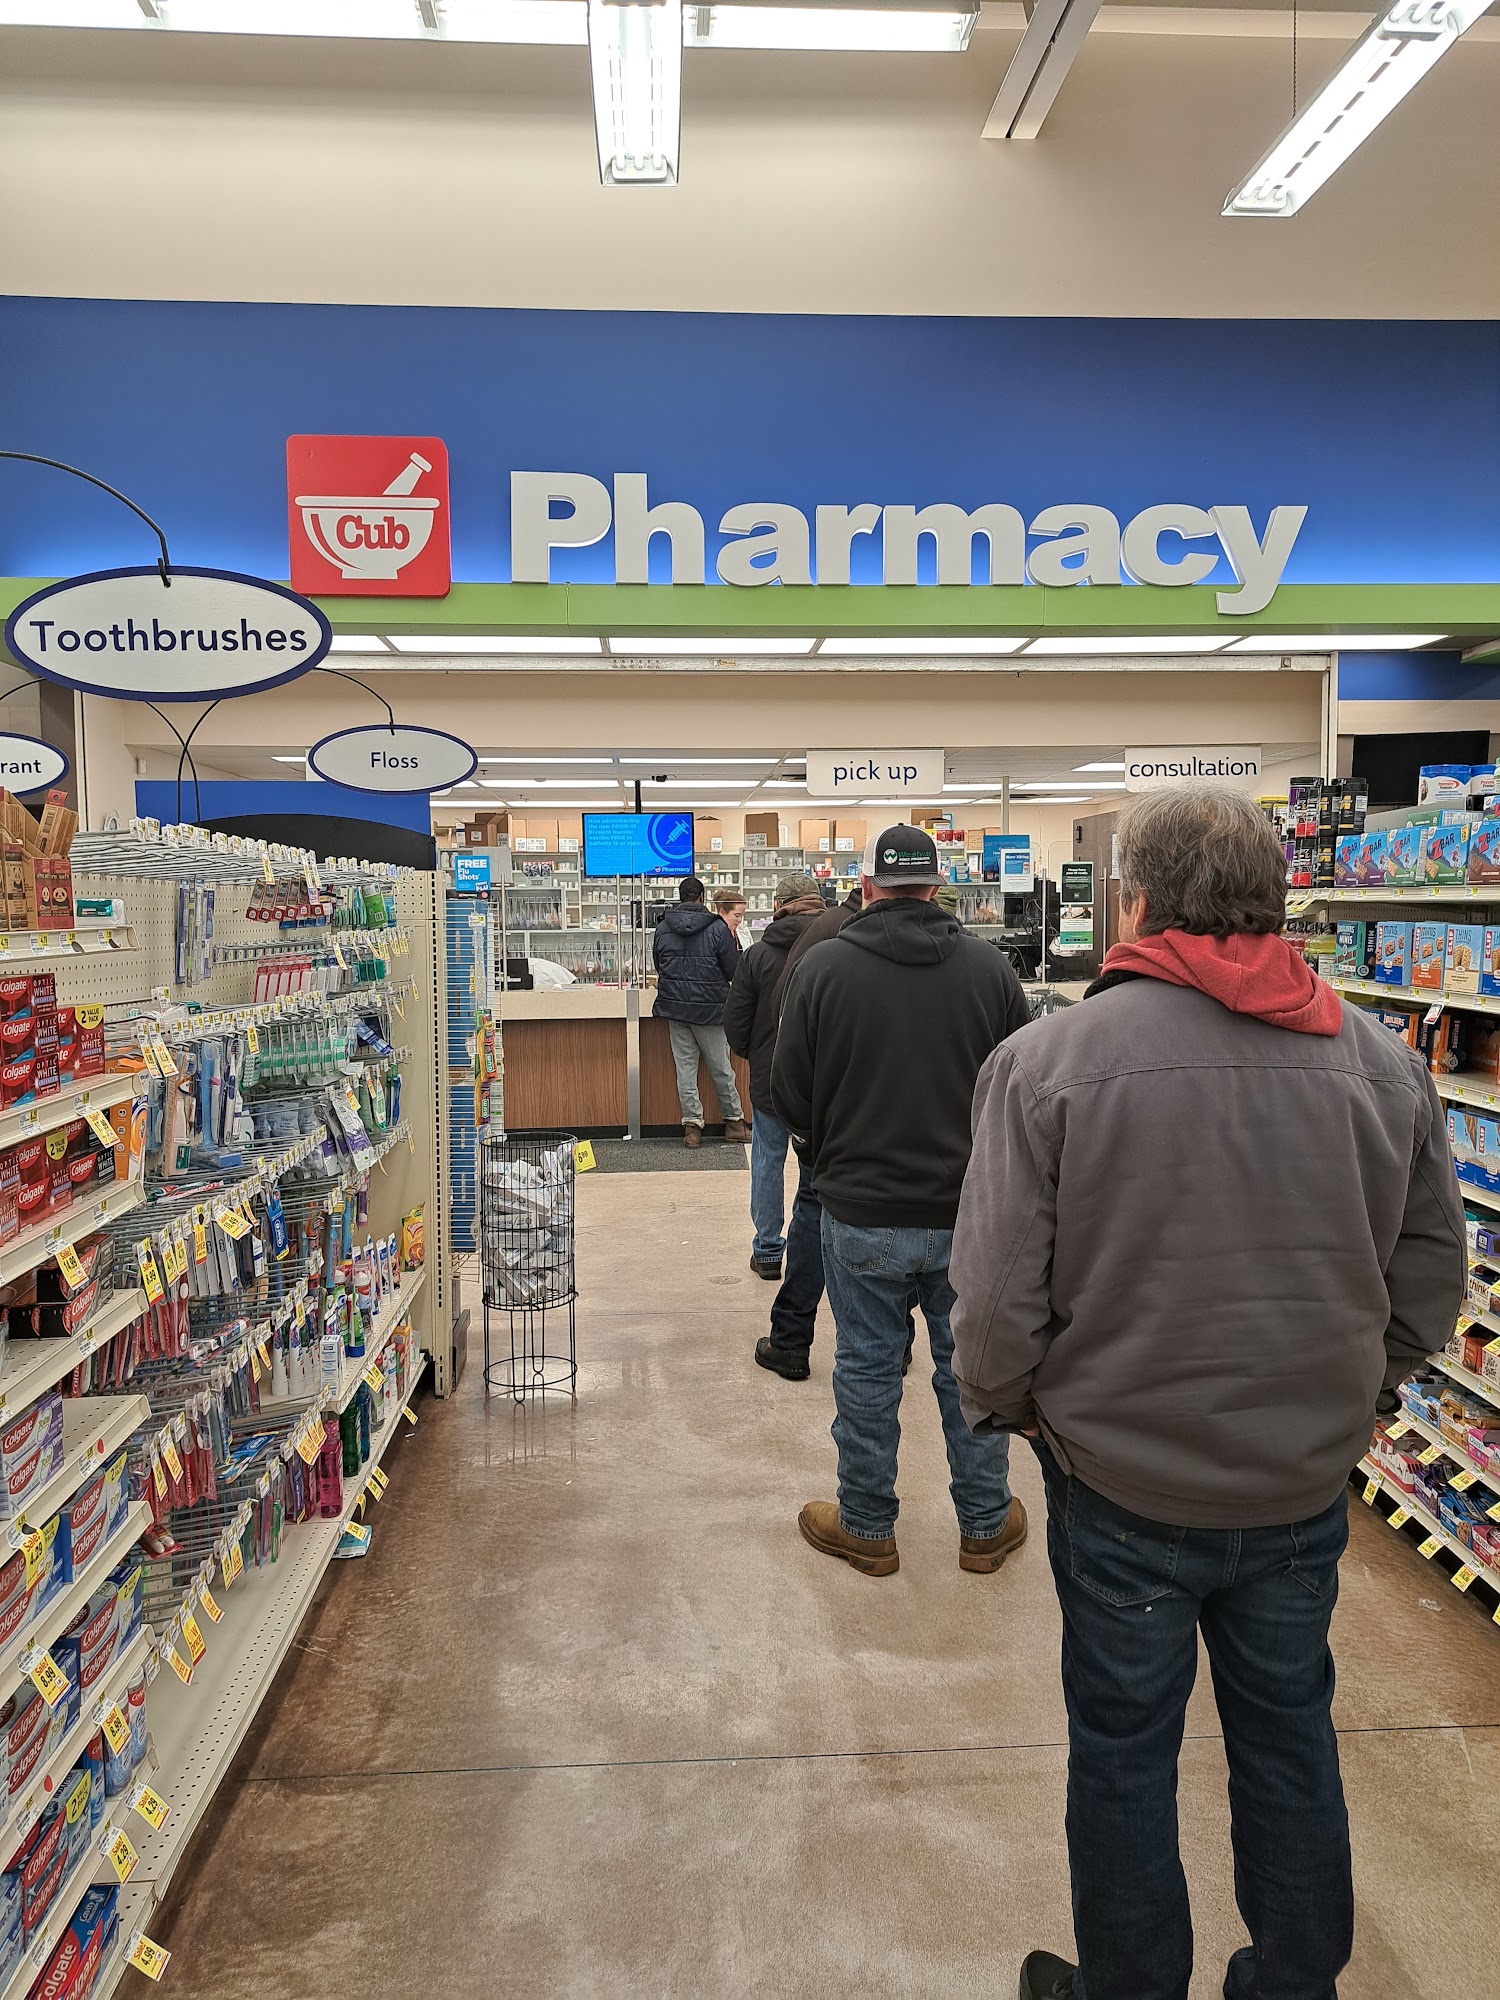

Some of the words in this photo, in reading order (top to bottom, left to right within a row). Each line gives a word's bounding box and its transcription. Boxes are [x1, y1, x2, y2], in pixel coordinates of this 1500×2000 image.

[336, 514, 411, 551] Cub
[510, 470, 1309, 616] Pharmacy
[30, 618, 308, 652] Toothbrushes
[0, 759, 42, 774] rant
[370, 752, 419, 769] Floss
[1129, 756, 1258, 778] consultation
[833, 759, 880, 786] pick
[887, 766, 918, 786] up
[457, 859, 488, 869] FREE
[898, 851, 932, 859] Westway
[1455, 928, 1472, 942] THINS
[0, 980, 27, 995] Colgate
[33, 977, 54, 987] OPTIC
[33, 985, 55, 997] WHITE
[81, 1010, 87, 1024] 2
[87, 1008, 100, 1016] VALUE
[88, 1014, 99, 1023] PACK
[3, 1022, 31, 1037] Colgate
[36, 1017, 57, 1028] OPTIC
[37, 1025, 58, 1038] WHITE
[81, 1031, 101, 1041] OPTIC
[81, 1038, 102, 1050] WHITE
[2, 1063, 31, 1080] Colgate
[36, 1057, 57, 1070] OPTIC
[37, 1066, 58, 1080] WHITE
[50, 1144, 55, 1156] 2
[0, 1164, 20, 1181] WHITE
[71, 1159, 94, 1176] Colgate
[52, 1174, 70, 1188] WHITE
[18, 1183, 45, 1204] Colgate
[1469, 1278, 1489, 1298] think!
[72, 1289, 94, 1316] Colgate
[4, 1418, 34, 1450] Colgate
[10, 1458, 37, 1490] Colgate
[110, 1468, 115, 1481] 2
[72, 1487, 101, 1524] Colgate
[23, 1530, 41, 1553] Sale!
[74, 1521, 103, 1558] Colgate
[0, 1557, 25, 1596] lgate
[123, 1584, 128, 1599] 2
[82, 1607, 112, 1648] Colgate
[34, 1657, 49, 1677] Sale!
[83, 1641, 114, 1682] Colgate
[40, 1666, 56, 1688] 8.99
[8, 1699, 43, 1750] Colgate
[105, 1708, 117, 1727] Sale!
[109, 1717, 123, 1738] 8.99
[8, 1736, 43, 1788] Colgate
[70, 1797, 78, 1819] 2
[77, 1789, 89, 1808] PACK
[138, 1790, 151, 1809] Sale!
[145, 1797, 159, 1816] 4.29
[27, 1825, 61, 1881] Colgate
[111, 1835, 124, 1855] Sale!
[116, 1844, 130, 1865] 4.29
[28, 1862, 62, 1923] Colgate
[80, 1901, 95, 1922] Cavity
[133, 1940, 145, 1959] Sale!
[140, 1946, 156, 1966] 4.99
